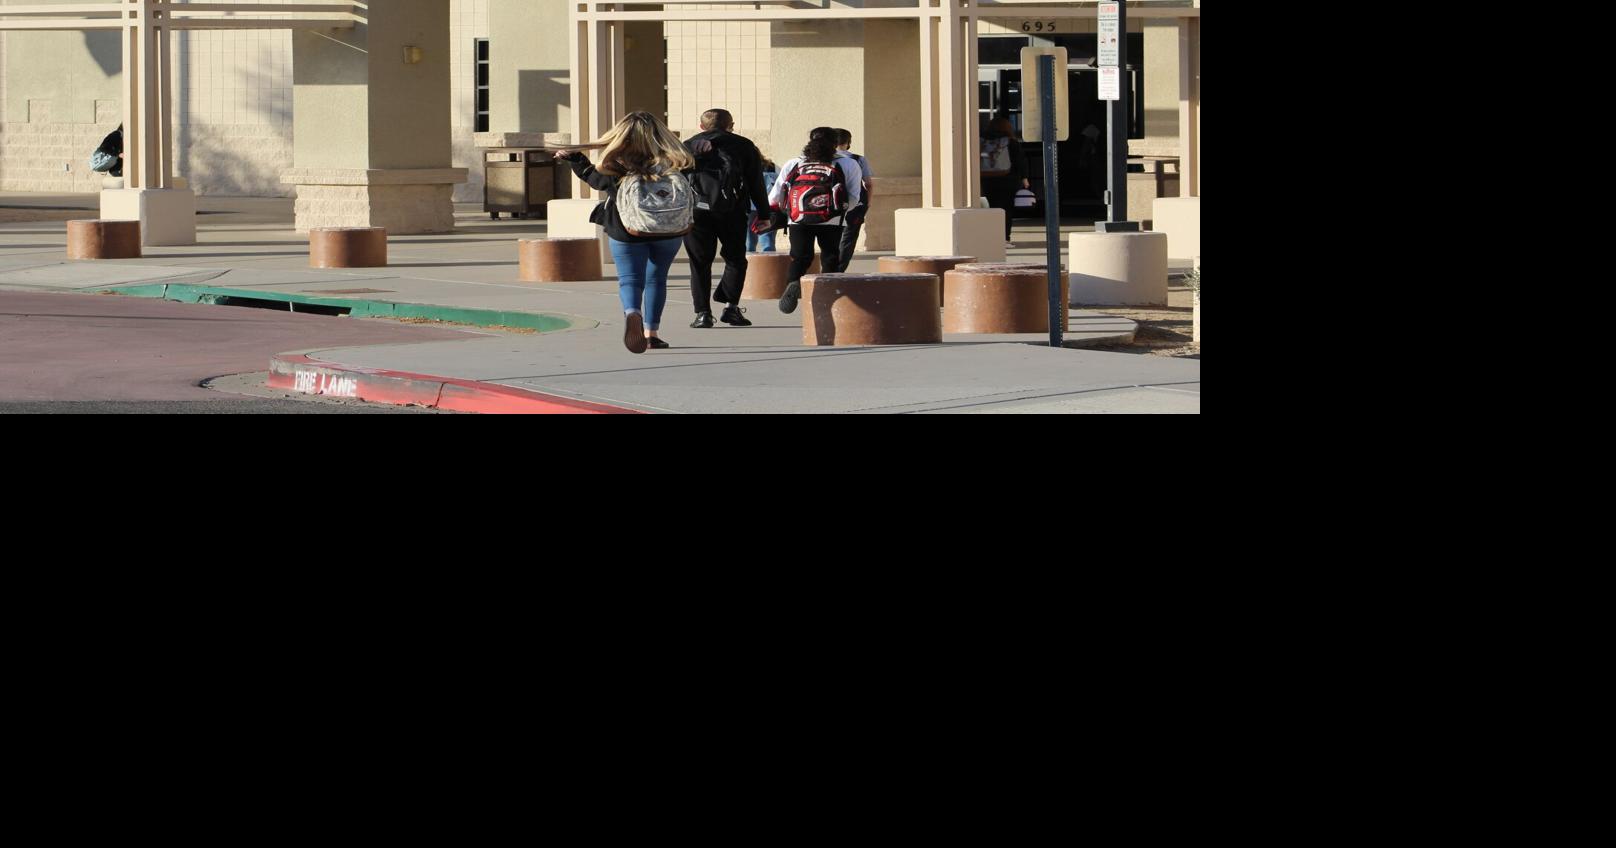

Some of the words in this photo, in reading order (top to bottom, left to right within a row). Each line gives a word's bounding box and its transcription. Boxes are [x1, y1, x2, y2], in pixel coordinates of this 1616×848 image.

[1022, 21, 1055, 31] 695
[294, 370, 317, 393] FIRE
[320, 373, 357, 397] LANE
